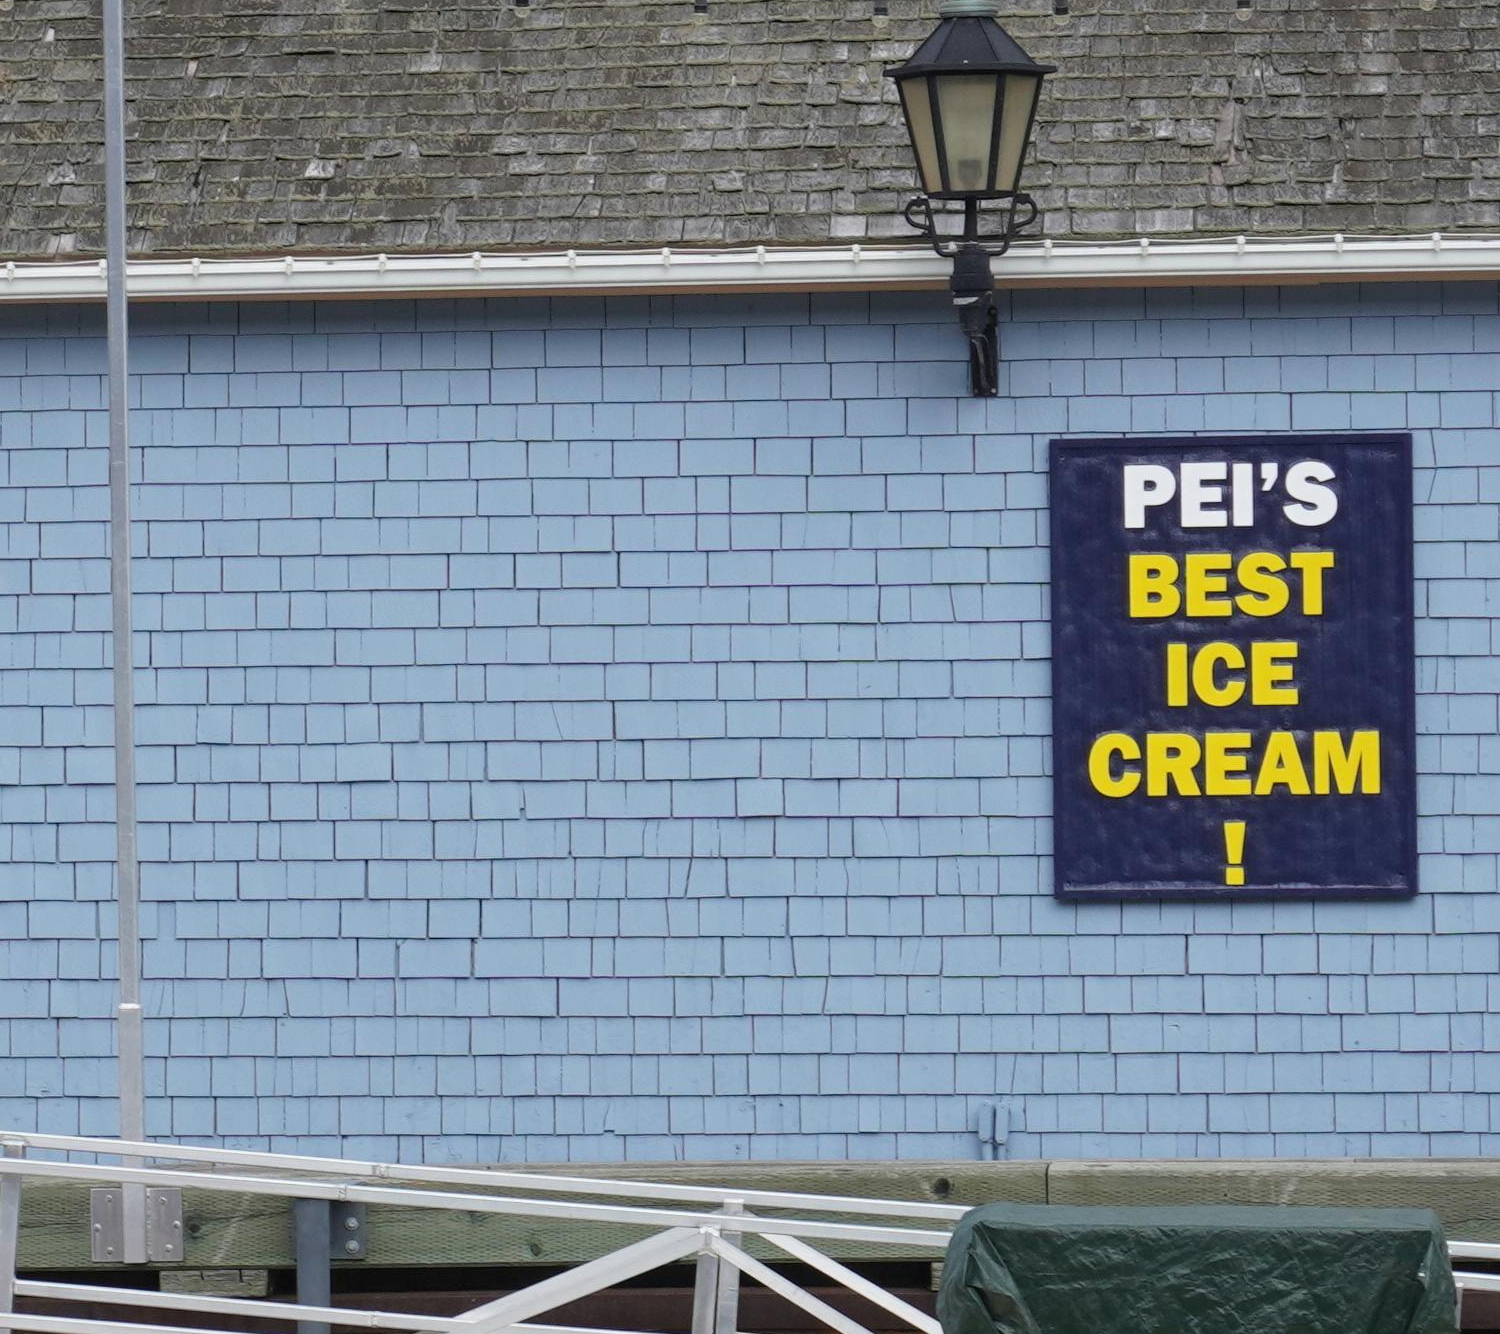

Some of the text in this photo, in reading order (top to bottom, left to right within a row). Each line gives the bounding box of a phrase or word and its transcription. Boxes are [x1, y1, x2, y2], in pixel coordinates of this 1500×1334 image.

[1123, 459, 1338, 529] PEI'S
[1127, 551, 1335, 618] BEST
[1167, 641, 1300, 707] ICE
[1088, 730, 1381, 798] CREAM
[1223, 820, 1247, 886] !
